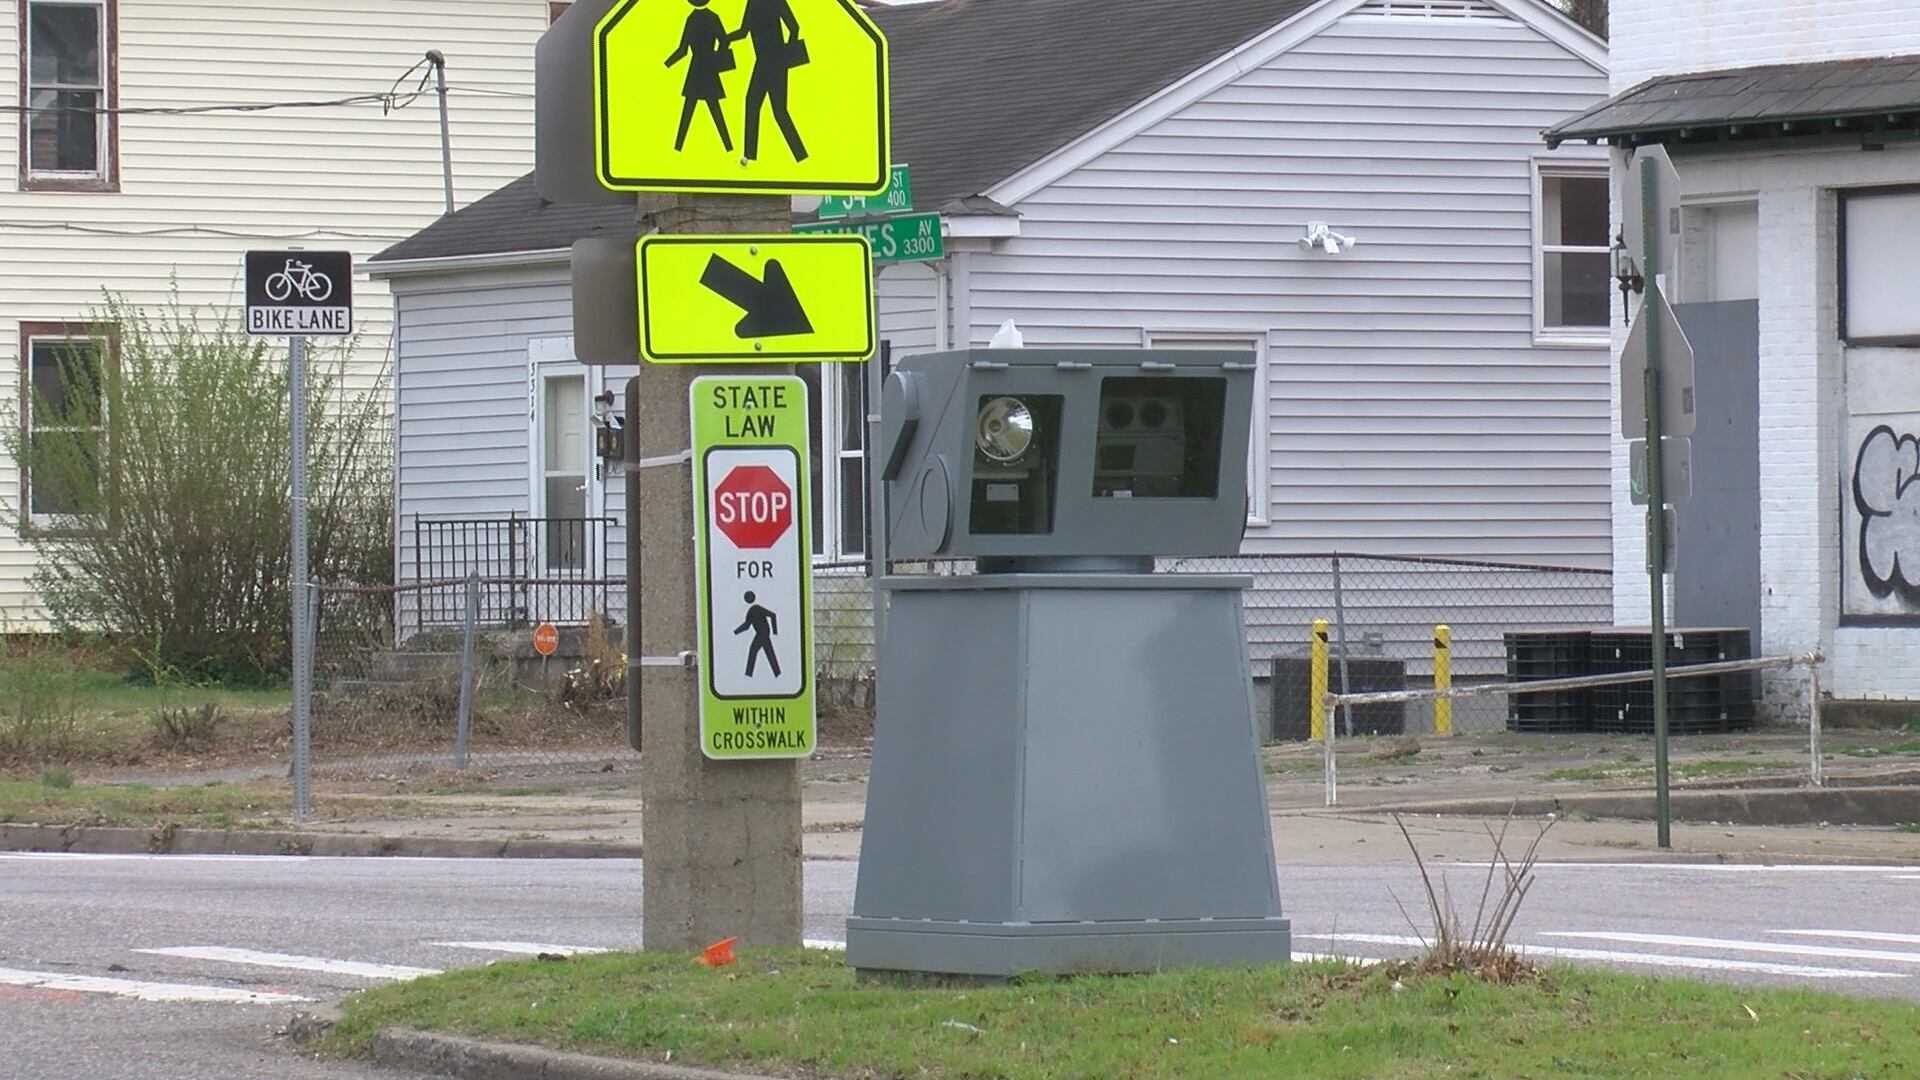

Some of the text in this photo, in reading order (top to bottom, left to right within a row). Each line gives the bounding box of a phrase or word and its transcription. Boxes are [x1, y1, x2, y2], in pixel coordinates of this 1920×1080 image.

[893, 171, 903, 188] ST
[887, 190, 906, 207] 400
[918, 219, 932, 237] AV
[903, 236, 935, 255] 3300
[253, 309, 345, 329] BIKE LANE
[713, 385, 787, 409] STATE
[725, 415, 775, 438] LAW
[719, 491, 788, 523] STOP
[737, 561, 774, 579] FOR
[732, 707, 785, 725] WITHIN
[713, 730, 806, 750] CROSSWALK
